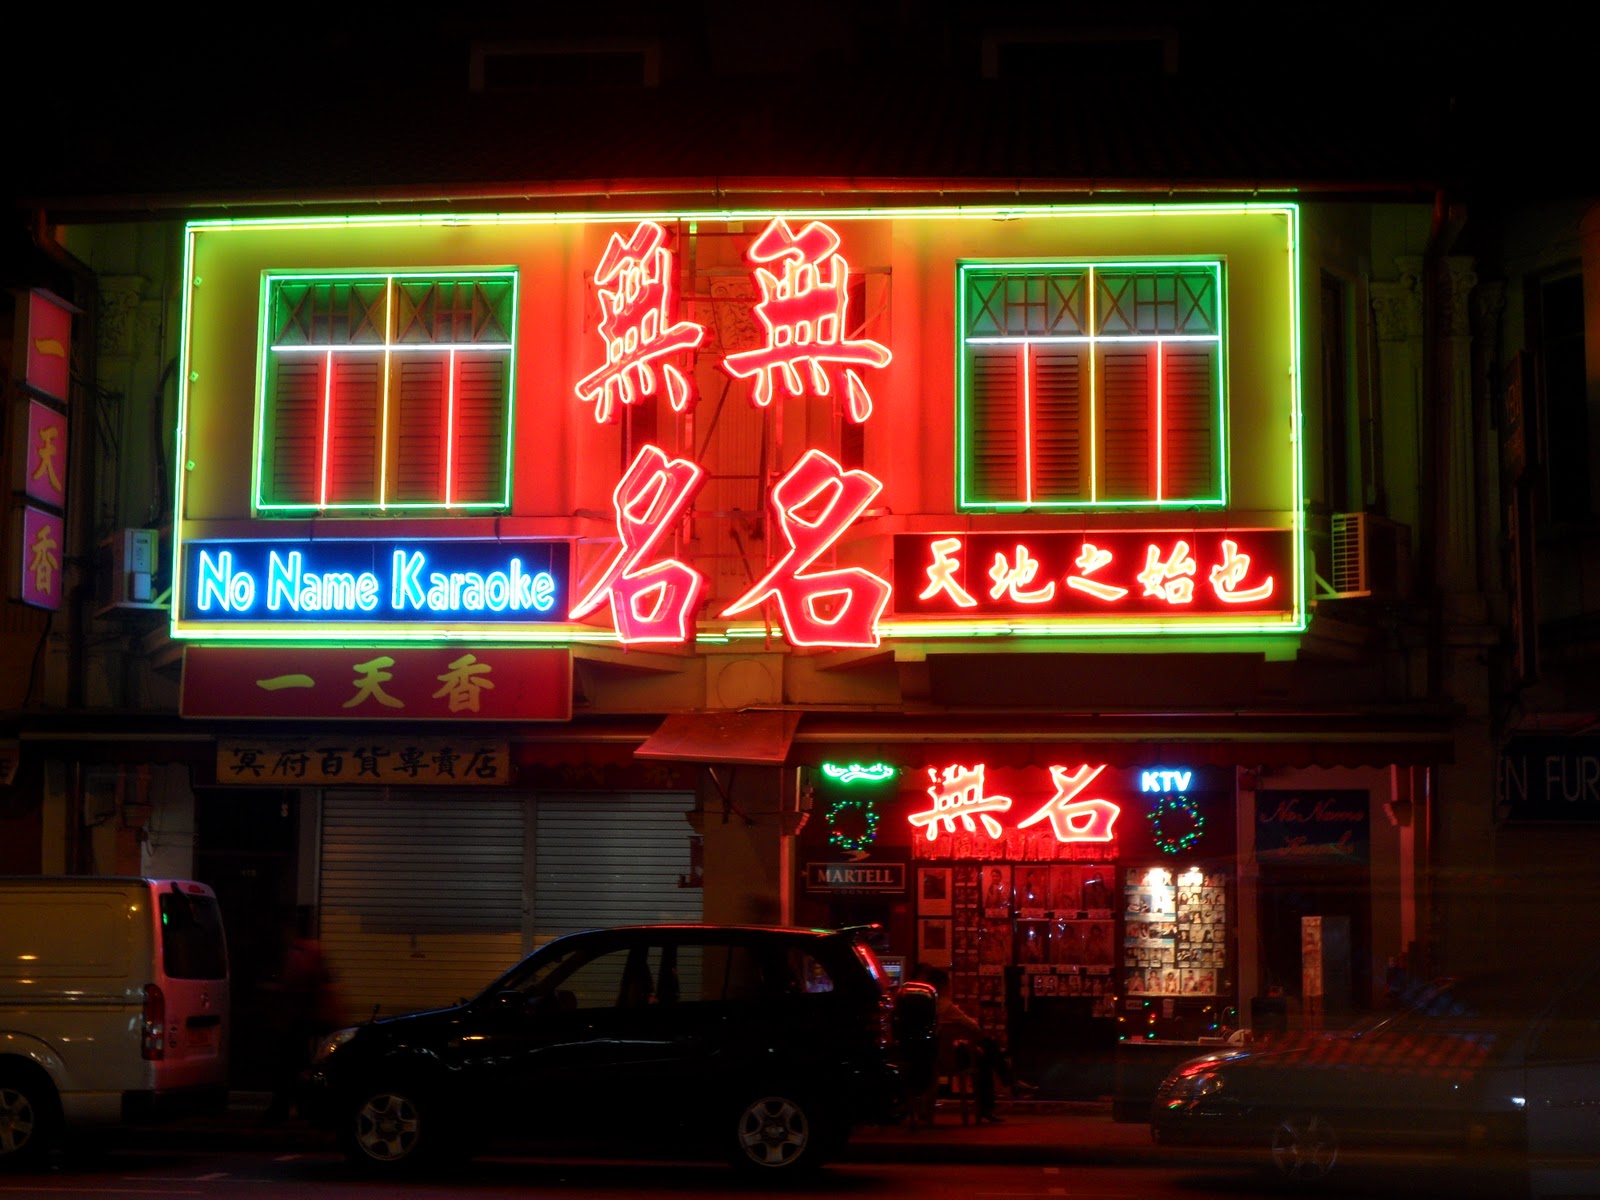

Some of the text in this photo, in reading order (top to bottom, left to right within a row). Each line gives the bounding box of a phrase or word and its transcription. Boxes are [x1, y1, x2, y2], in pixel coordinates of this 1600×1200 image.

[568, 220, 704, 644] 無名
[718, 216, 893, 648] 無名
[31, 338, 66, 595] 一天香
[197, 550, 555, 612] No Name Karaoke
[919, 537, 1274, 608] 天地之始也
[255, 653, 496, 714] 一天香
[1140, 770, 1192, 793] KTV
[1543, 752, 1600, 802] FUR
[817, 869, 894, 884] MARTELL
